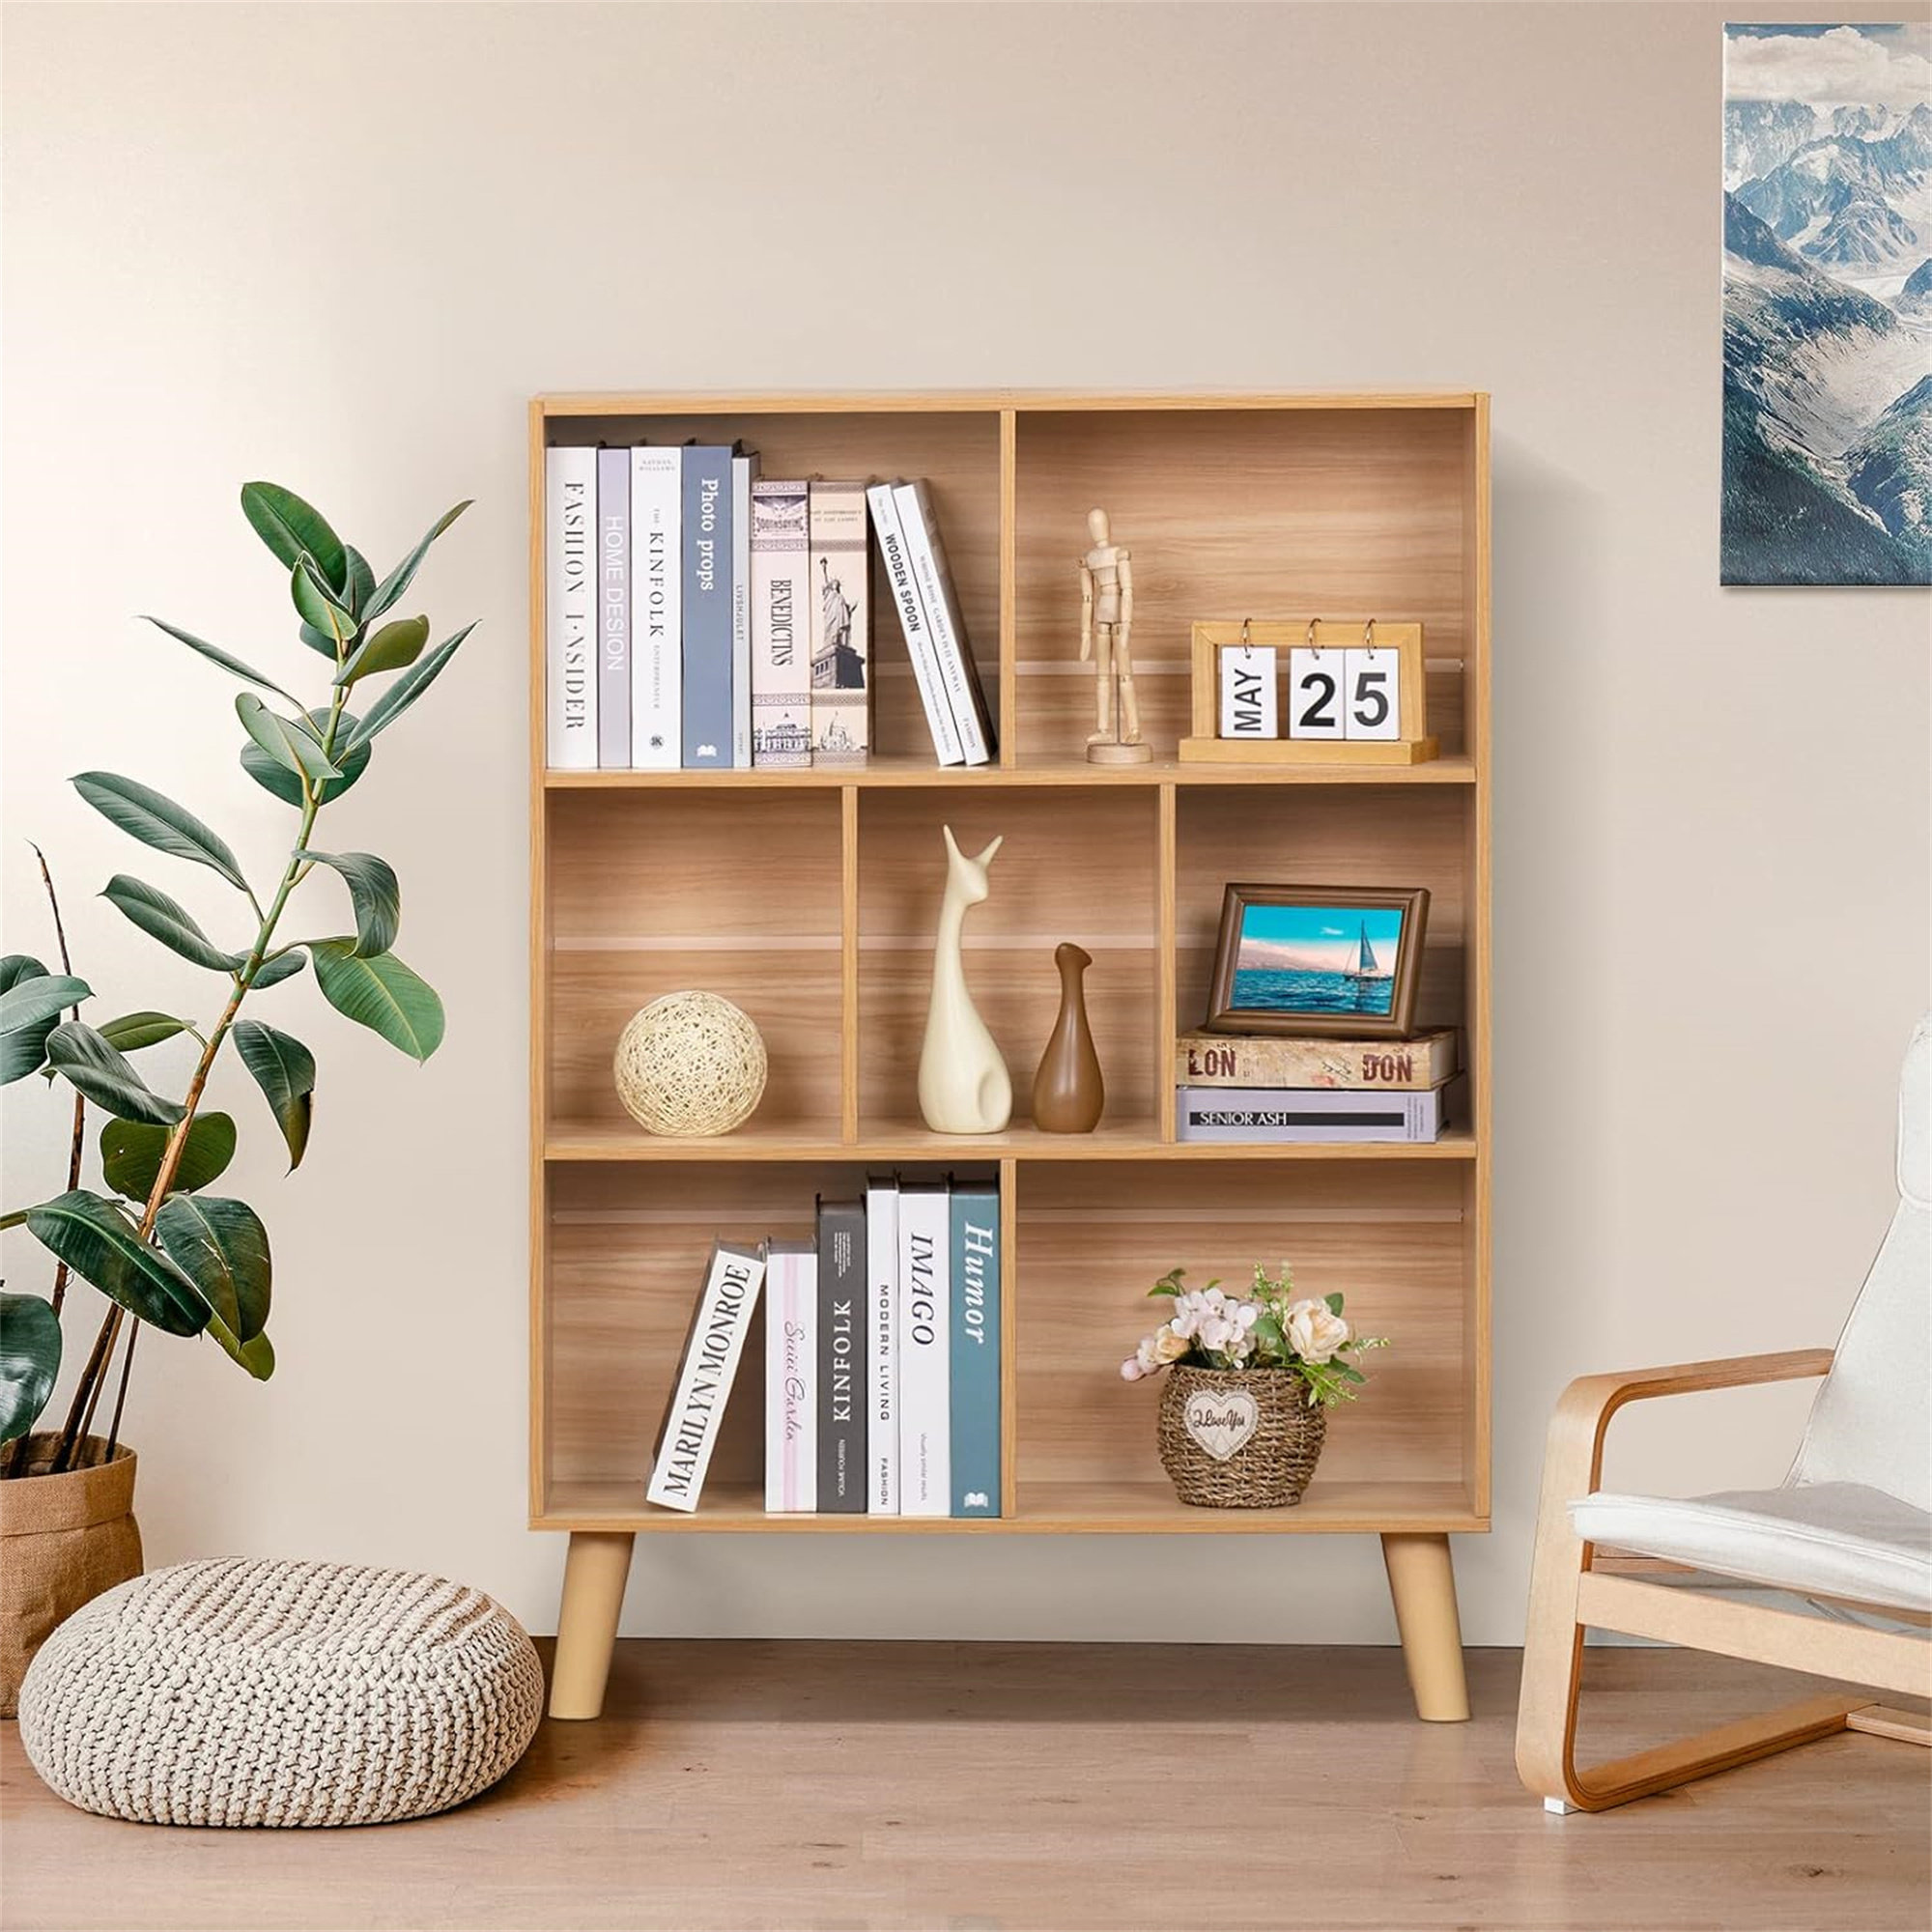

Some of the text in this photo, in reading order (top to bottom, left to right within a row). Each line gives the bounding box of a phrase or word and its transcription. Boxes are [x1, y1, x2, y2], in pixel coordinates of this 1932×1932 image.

[564, 482, 585, 592] FASHION
[605, 515, 624, 581] HOME
[649, 532, 665, 637] KINFOLK
[696, 478, 720, 591] Photo props
[884, 532, 921, 633] WOODEN SPOON
[770, 579, 793, 667] BENEDICTINS
[1234, 668, 1263, 731] MAY
[1188, 1049, 1412, 1082] LON DON
[1200, 1112, 1288, 1126] SENIOR ASH
[911, 1233, 935, 1346] IMAGO
[964, 1221, 994, 1344] Humor
[664, 1263, 751, 1497] MARILYN MONROE
[834, 1299, 852, 1422] KINFOLK
[880, 1284, 890, 1421] MODERN LIVING
[880, 1457, 889, 1506] FASHION
